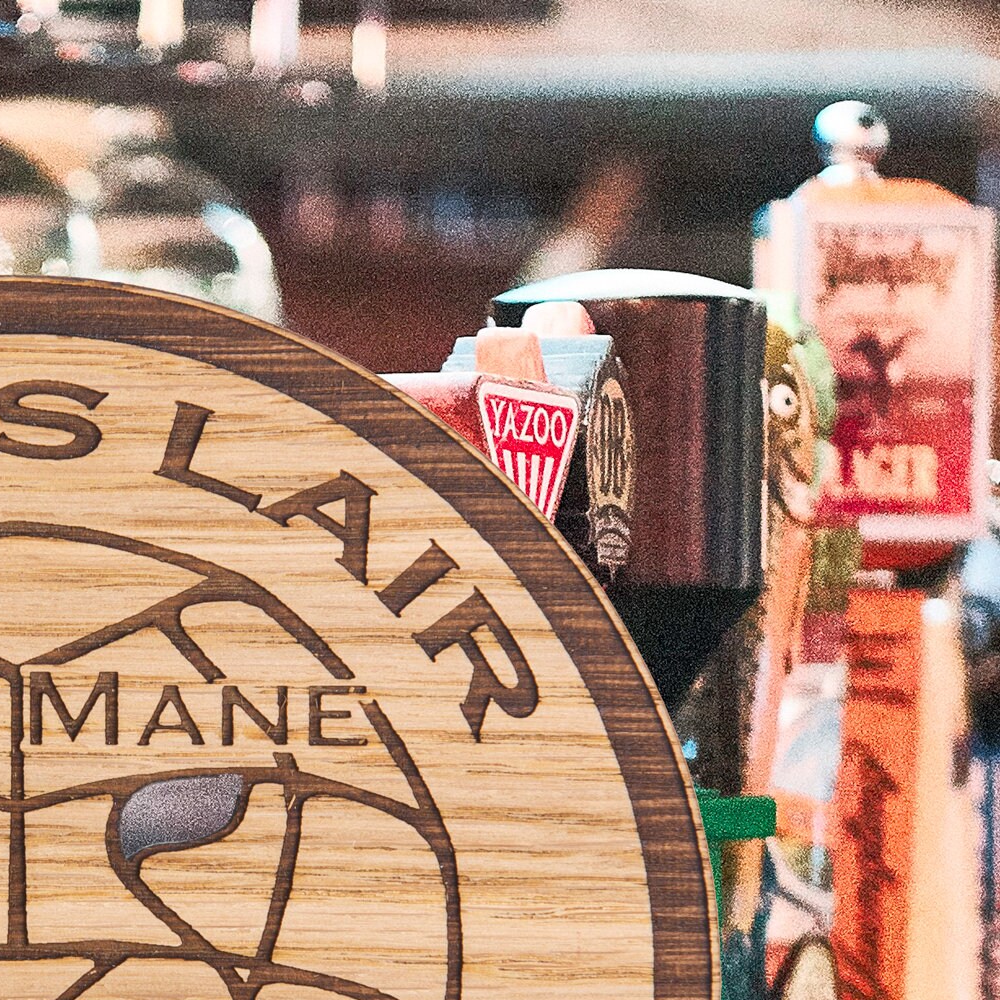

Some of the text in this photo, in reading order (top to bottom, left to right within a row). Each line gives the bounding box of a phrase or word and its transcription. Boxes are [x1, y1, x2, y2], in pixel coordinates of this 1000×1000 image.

[490, 399, 567, 447] YAZOO
[153, 401, 538, 742] LAIR
[29, 671, 367, 746] MANE
